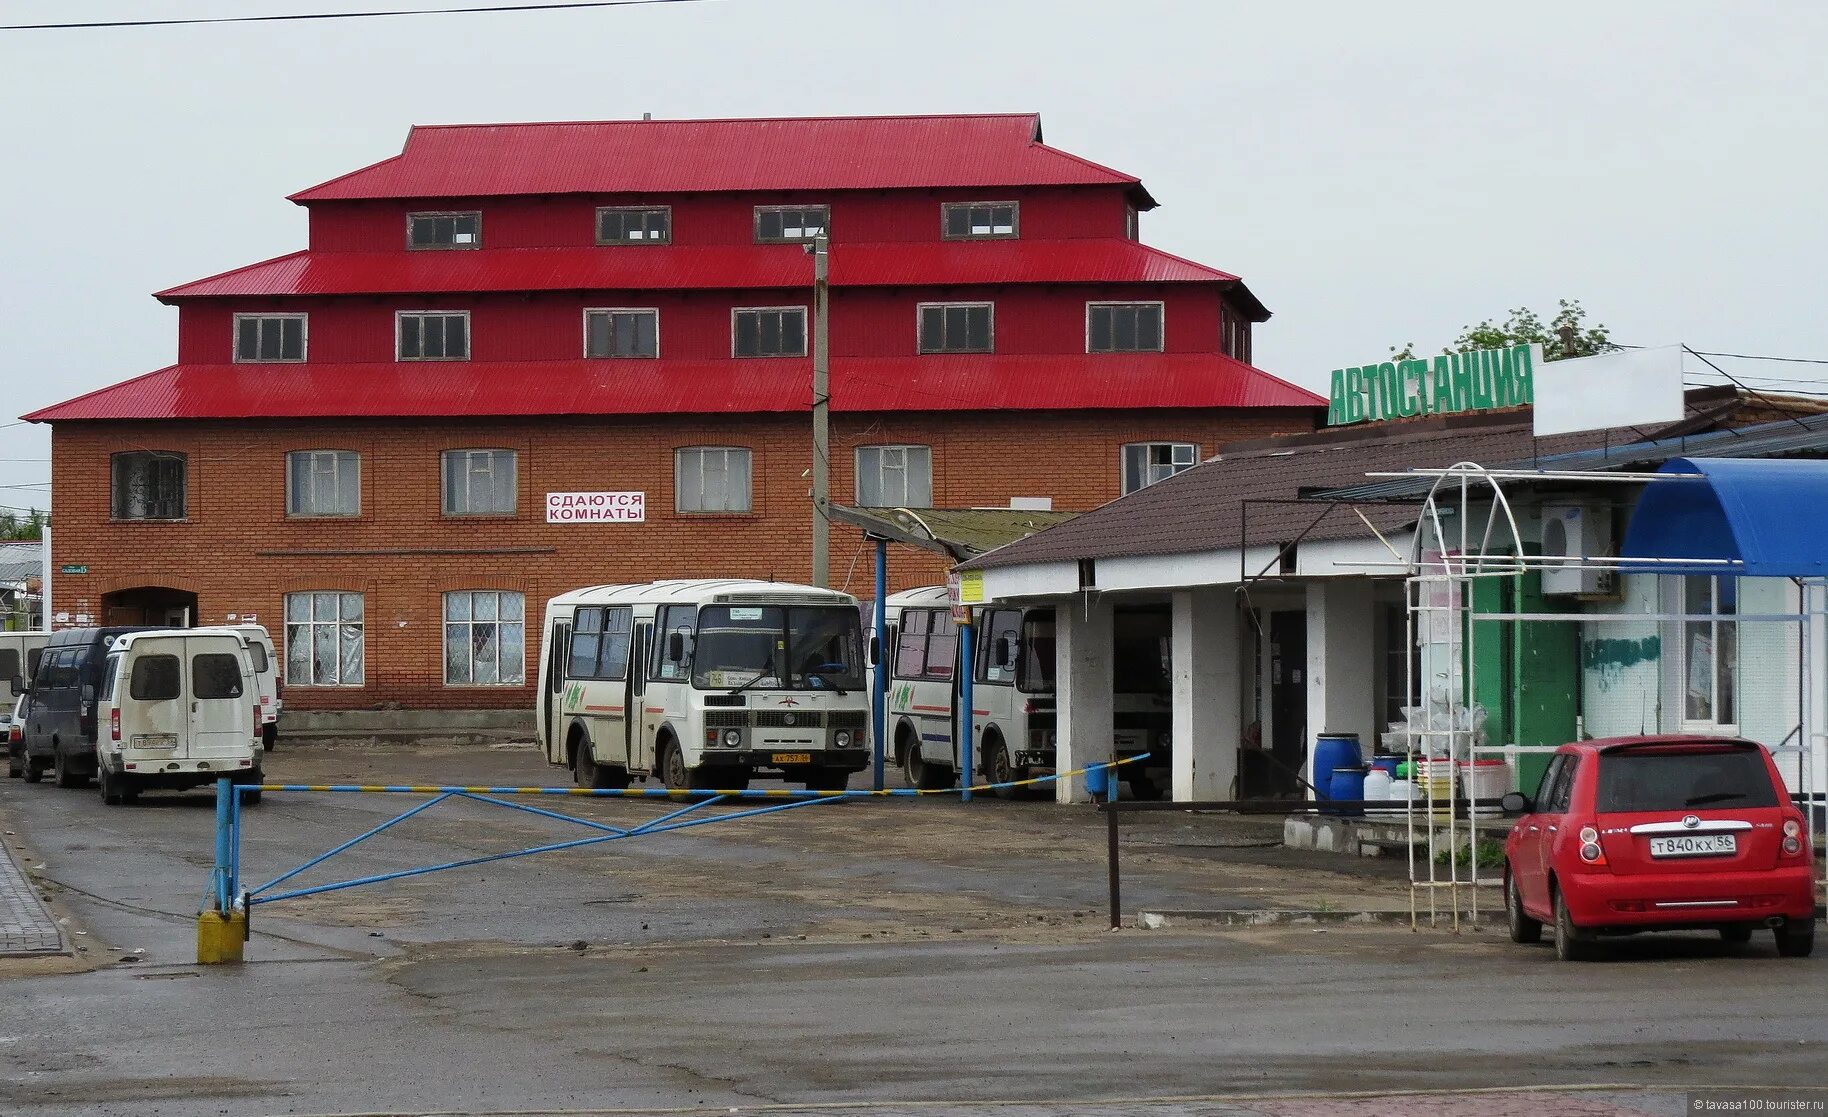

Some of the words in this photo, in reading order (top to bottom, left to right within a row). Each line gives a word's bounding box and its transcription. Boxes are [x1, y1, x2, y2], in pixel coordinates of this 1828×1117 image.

[1328, 344, 1533, 426] АВТОСТАНЦИЯ
[549, 495, 642, 508] СДАЮТСЯ
[550, 508, 642, 520] КОМНАТЫ
